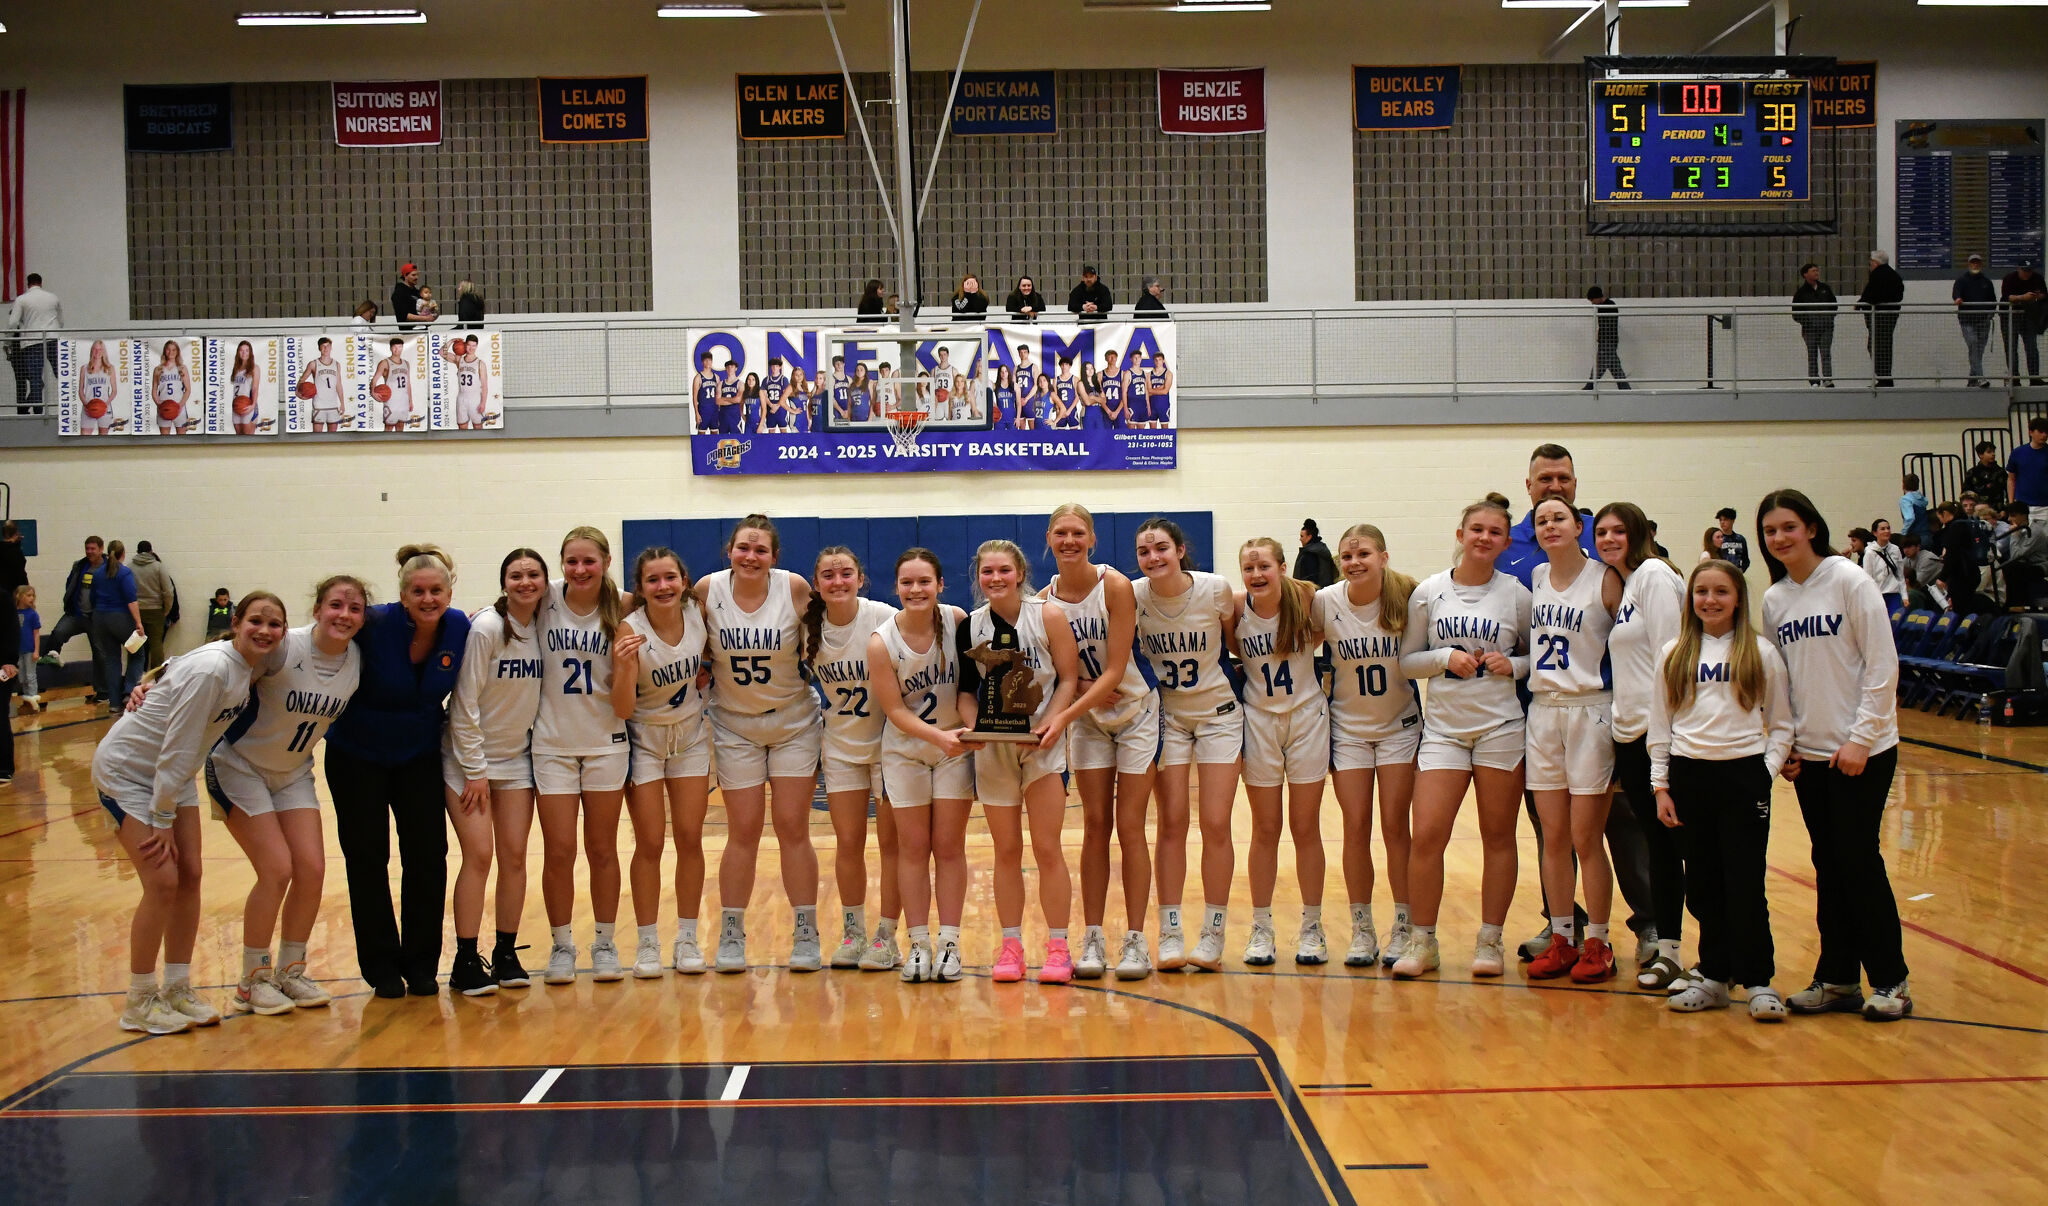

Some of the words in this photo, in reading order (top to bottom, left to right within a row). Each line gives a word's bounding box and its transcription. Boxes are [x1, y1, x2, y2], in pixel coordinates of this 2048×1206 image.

[744, 85, 787, 102] GLEN
[796, 84, 839, 100] LAKE
[964, 81, 1040, 98] ONEKAMA
[1183, 81, 1242, 98] BENZIE
[1370, 76, 1445, 93] BUCKLEY
[1605, 84, 1648, 96] HOME
[1753, 83, 1802, 96] GUEST
[337, 92, 404, 108] SUTTONS
[409, 90, 438, 108] BAY
[561, 88, 626, 105] LELAND
[1682, 85, 1721, 113] 0.0
[139, 103, 217, 117] BRETHREN
[760, 108, 825, 126] LAKERS
[954, 104, 1051, 122] PORTAGERS
[1178, 104, 1247, 121] HUSKIES
[1381, 100, 1434, 117] BEARS
[1612, 104, 1646, 132] 51
[1763, 103, 1796, 131] 38
[1814, 99, 1866, 116] THERS
[147, 121, 212, 135] BOBCATS
[345, 115, 432, 133] NORSEMEN
[562, 112, 627, 130] COMETS
[1662, 130, 1706, 139] PERIOD
[1714, 124, 1727, 145] 4
[1611, 156, 1641, 164] FOULS
[1670, 155, 1734, 164] PLAYER-FOUL
[1762, 155, 1791, 163] FOULS
[1622, 167, 1635, 188] 2
[1773, 166, 1786, 187] 5
[1609, 191, 1643, 199] POINTS
[1671, 191, 1704, 199] MATCH
[1760, 190, 1793, 198] POINTS
[60, 340, 69, 377] GUNIA
[119, 340, 128, 383] SENIOR
[134, 340, 142, 386] ZIELINSKI
[192, 340, 201, 383] SENIOR
[209, 339, 219, 386] JOHNSON
[268, 340, 277, 383] SENIOR
[287, 337, 297, 392] BRADFORD
[346, 337, 355, 380] SENIOR
[358, 336, 366, 375] SINKE
[417, 337, 426, 380] SENIOR
[432, 334, 441, 389] BRADFORD
[491, 333, 500, 377] SENIOR
[167, 383, 174, 395] 5
[397, 376, 406, 388] 12
[460, 374, 473, 386] 33
[938, 379, 949, 389] 33
[1018, 377, 1028, 388] 24
[1135, 384, 1145, 395] 23
[93, 386, 102, 398] 15
[705, 388, 715, 399] 14
[769, 390, 780, 400] 32
[839, 389, 848, 400] 11
[1061, 390, 1068, 401] 2
[1106, 388, 1119, 400] 44
[61, 382, 70, 433] MADELYN
[134, 389, 143, 433] HEATHER
[208, 390, 217, 432] BRENNA
[289, 396, 298, 430] CADEN
[358, 384, 366, 429] MASON
[433, 393, 441, 427] ARDEN
[956, 409, 961, 419] 5
[1003, 399, 1009, 408] 11
[1035, 408, 1044, 418] 22
[1138, 433, 1173, 441] Excavating
[707, 440, 752, 465] PORTAGERS
[778, 446, 818, 459] 2024
[837, 445, 877, 458] 2025
[882, 443, 963, 457] VARSITY
[968, 442, 1090, 457] BASKETBALL
[1530, 604, 1583, 632] ONEKAMA
[719, 627, 781, 651] ONEKAMA
[1436, 616, 1500, 644] ONEKAMA
[1776, 614, 1842, 647] FAMILY
[547, 628, 609, 656] ONEKAMA
[1148, 631, 1207, 655] ONEKAMA
[1337, 637, 1399, 660] ONEKAMA
[1536, 633, 1569, 670] 23
[497, 658, 543, 679] FAMI
[562, 658, 593, 695] 21
[652, 653, 701, 688] ONEKAM
[730, 655, 772, 686] 55
[1160, 658, 1199, 689] 33
[1261, 660, 1293, 697] 14
[1355, 664, 1387, 697] 10
[669, 683, 687, 709] 4
[835, 686, 870, 717] 22
[987, 675, 995, 714] CHAMPION
[919, 693, 938, 724] 2
[994, 718, 1026, 726] Basketball
[287, 721, 317, 752] 11
